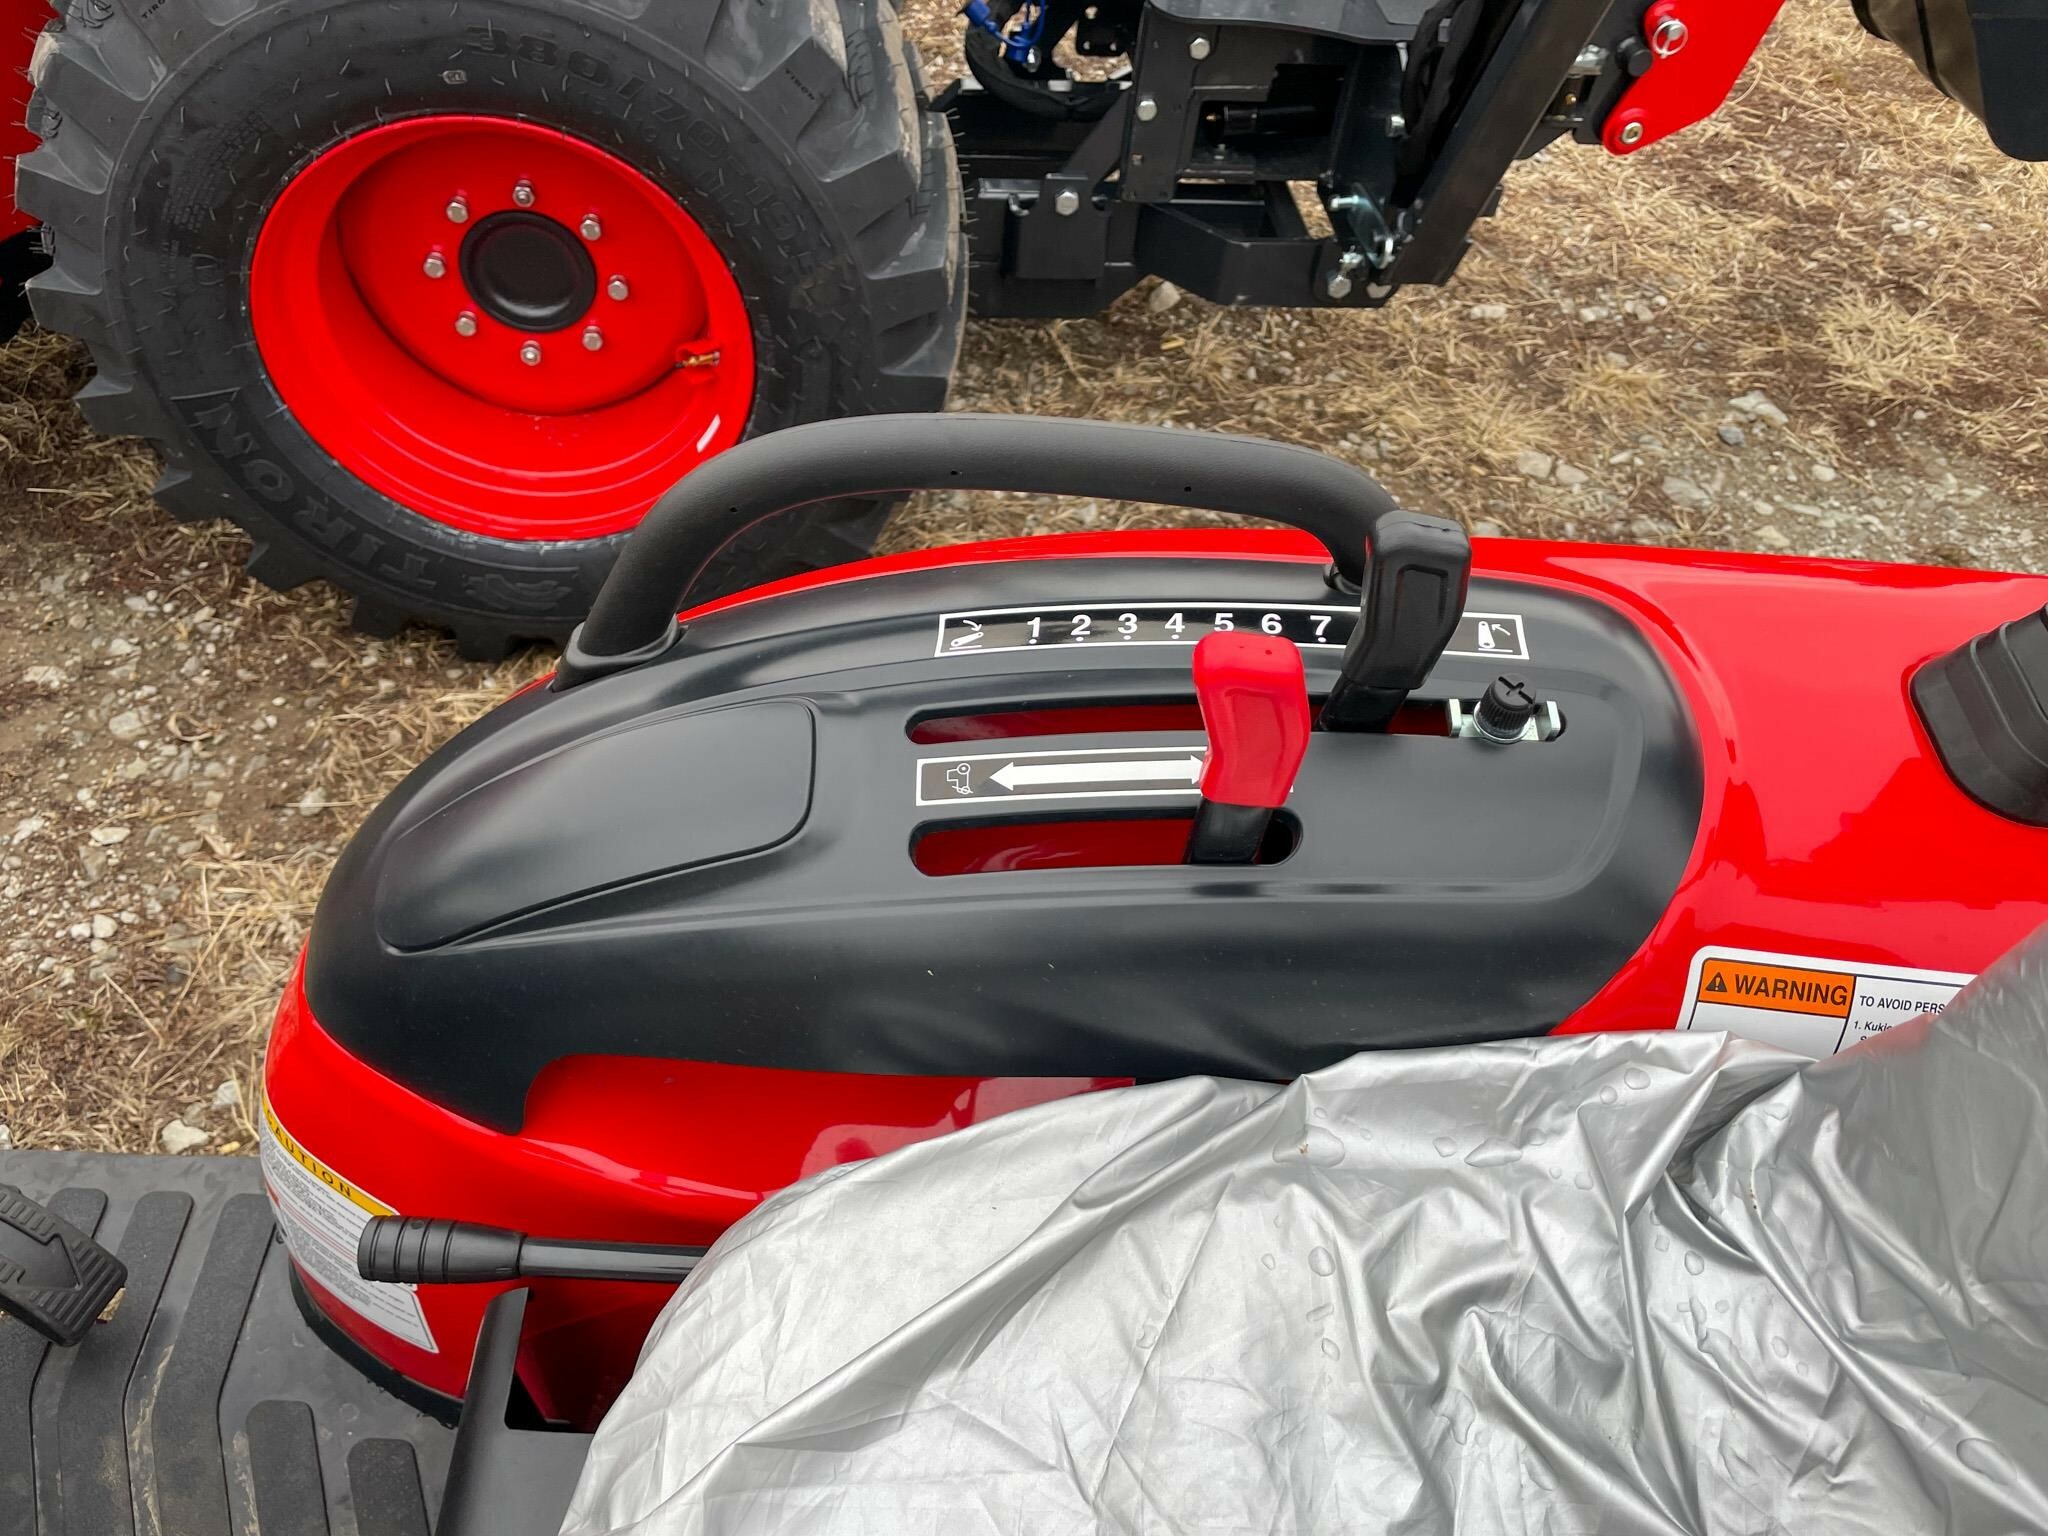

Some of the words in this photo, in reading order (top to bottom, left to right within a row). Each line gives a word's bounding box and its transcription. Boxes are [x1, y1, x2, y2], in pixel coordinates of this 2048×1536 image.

[193, 401, 439, 589] TIRON
[1027, 616, 1041, 637] 1
[1070, 614, 1092, 636] 2
[1117, 612, 1138, 634] 3
[1164, 612, 1186, 633] 4
[1213, 612, 1235, 633] 5
[1260, 612, 1283, 635] 6
[1309, 614, 1333, 636] 7
[1734, 973, 1848, 1006] WARNING
[1860, 995, 1875, 1008] TO
[1877, 997, 1912, 1012] AVOID
[1854, 1020, 1861, 1030] 1.
